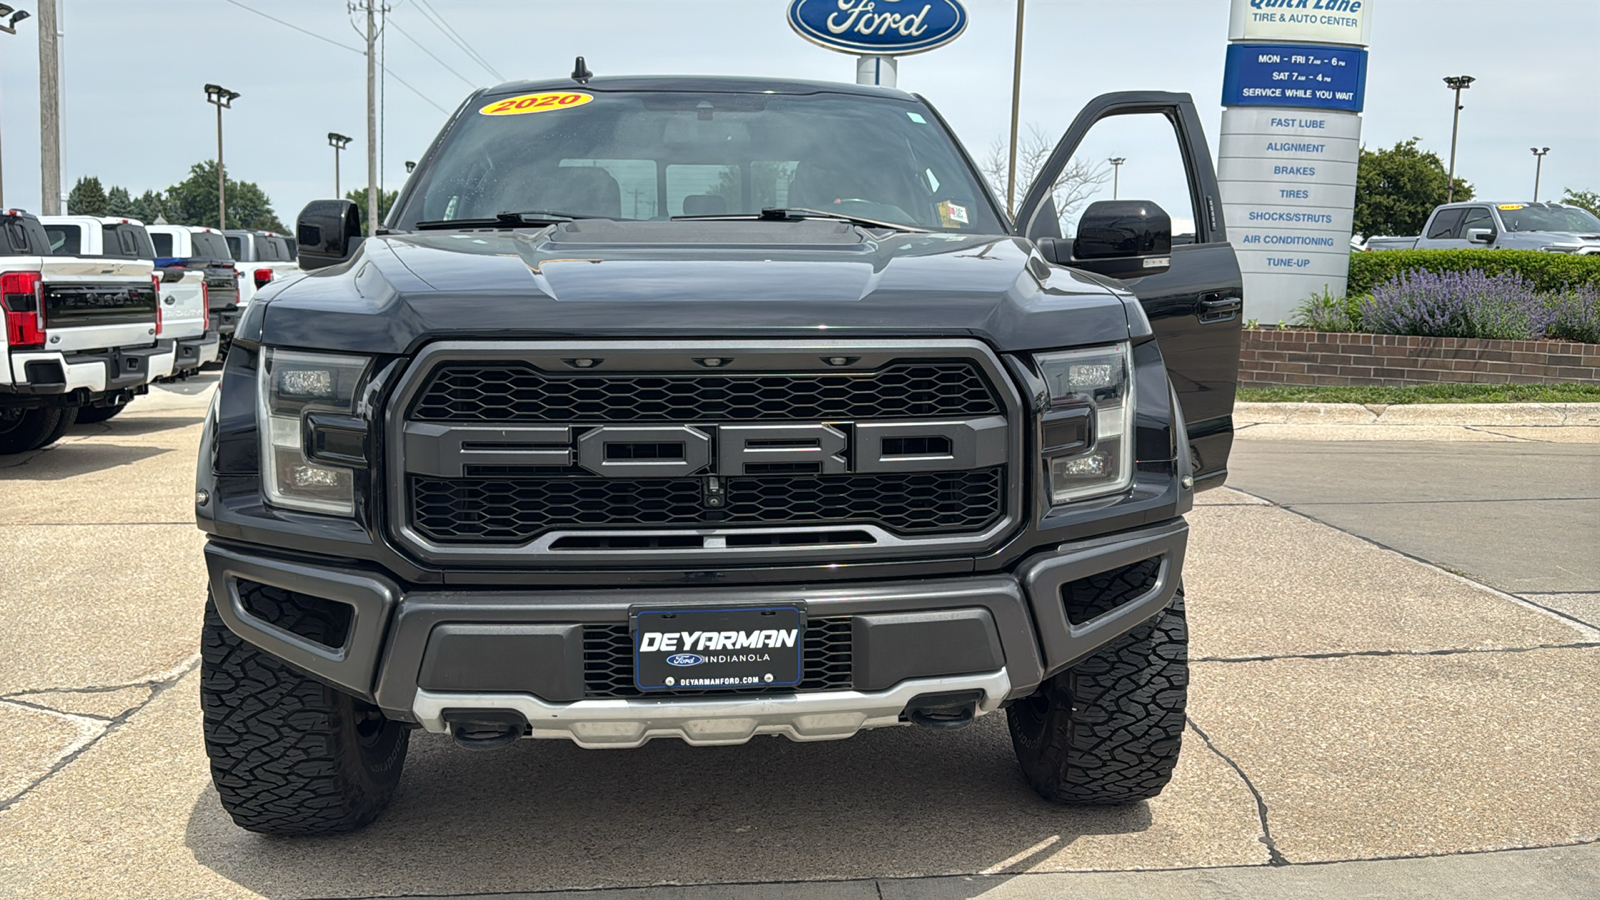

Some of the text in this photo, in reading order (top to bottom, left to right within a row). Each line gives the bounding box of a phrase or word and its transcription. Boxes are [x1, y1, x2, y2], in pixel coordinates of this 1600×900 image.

[826, 0, 931, 37] Ford
[1252, 12, 1358, 27] TIRE & AUTO CENTER
[1258, 54, 1280, 63] MON
[1291, 55, 1305, 64] FRI
[1272, 71, 1290, 81] SAT
[1242, 88, 1354, 101] SERVICE WHILE YOU WAIT
[490, 95, 581, 113] 2020
[1271, 118, 1325, 128] FAST LUBE
[1267, 143, 1325, 152] ALIGNMENT
[1274, 166, 1315, 176] BRAKES
[1280, 189, 1309, 199] TIRES
[1249, 211, 1332, 223] SHOCKS/STRUTS
[1243, 235, 1334, 247] AIR CONDITIONING
[1267, 258, 1310, 267] TUNE-UP
[405, 421, 1006, 477] FORD
[639, 628, 798, 652] DEYARMAN
[673, 654, 770, 664] Ford INDIANOLA
[680, 676, 759, 686] DEYARMANFORD.COM
